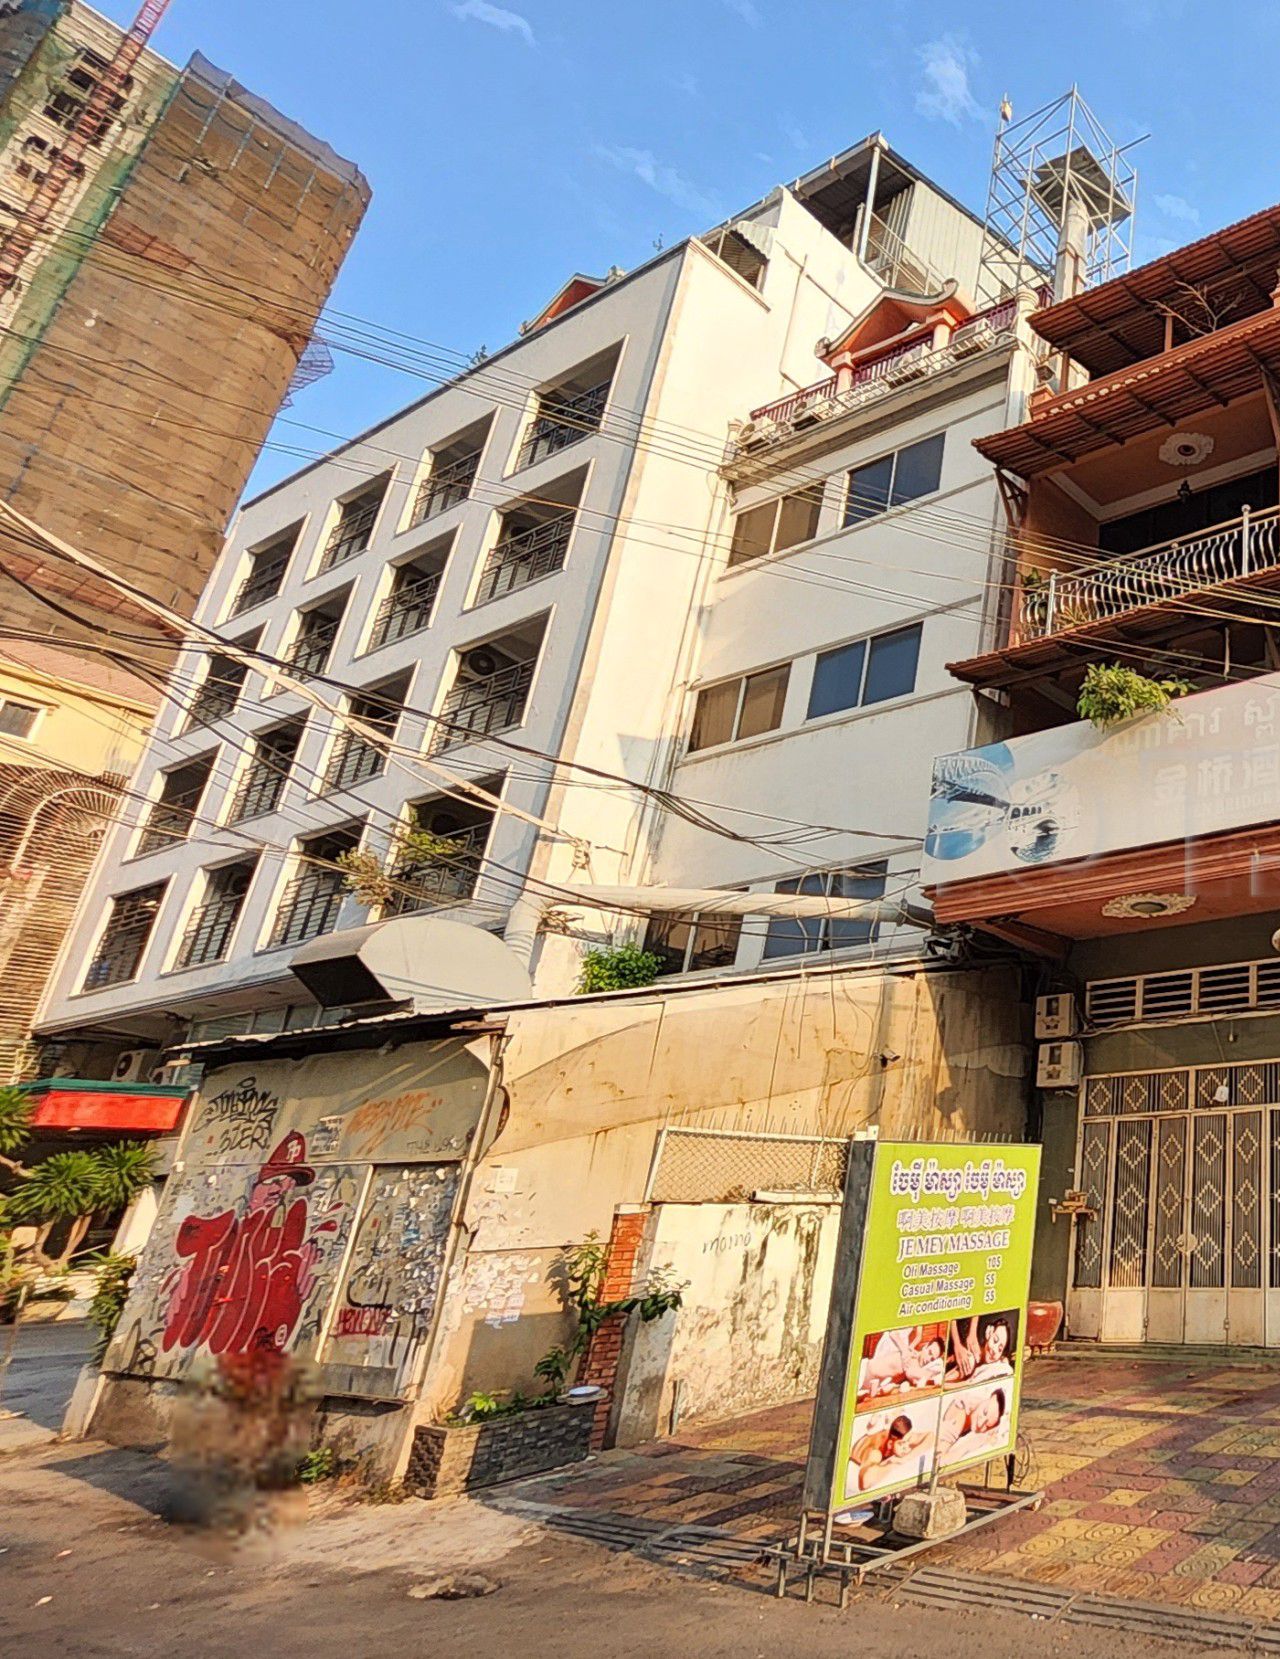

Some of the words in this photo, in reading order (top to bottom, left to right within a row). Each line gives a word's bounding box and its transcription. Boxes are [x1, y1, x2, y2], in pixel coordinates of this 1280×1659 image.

[917, 1235, 946, 1255] MEY
[948, 1229, 1009, 1252] MASSAGE
[920, 1262, 959, 1277] Massage
[901, 1282, 934, 1298] Casual
[936, 1277, 975, 1293] Massage
[899, 1302, 914, 1316] Air
[914, 1295, 972, 1314] conditioning
